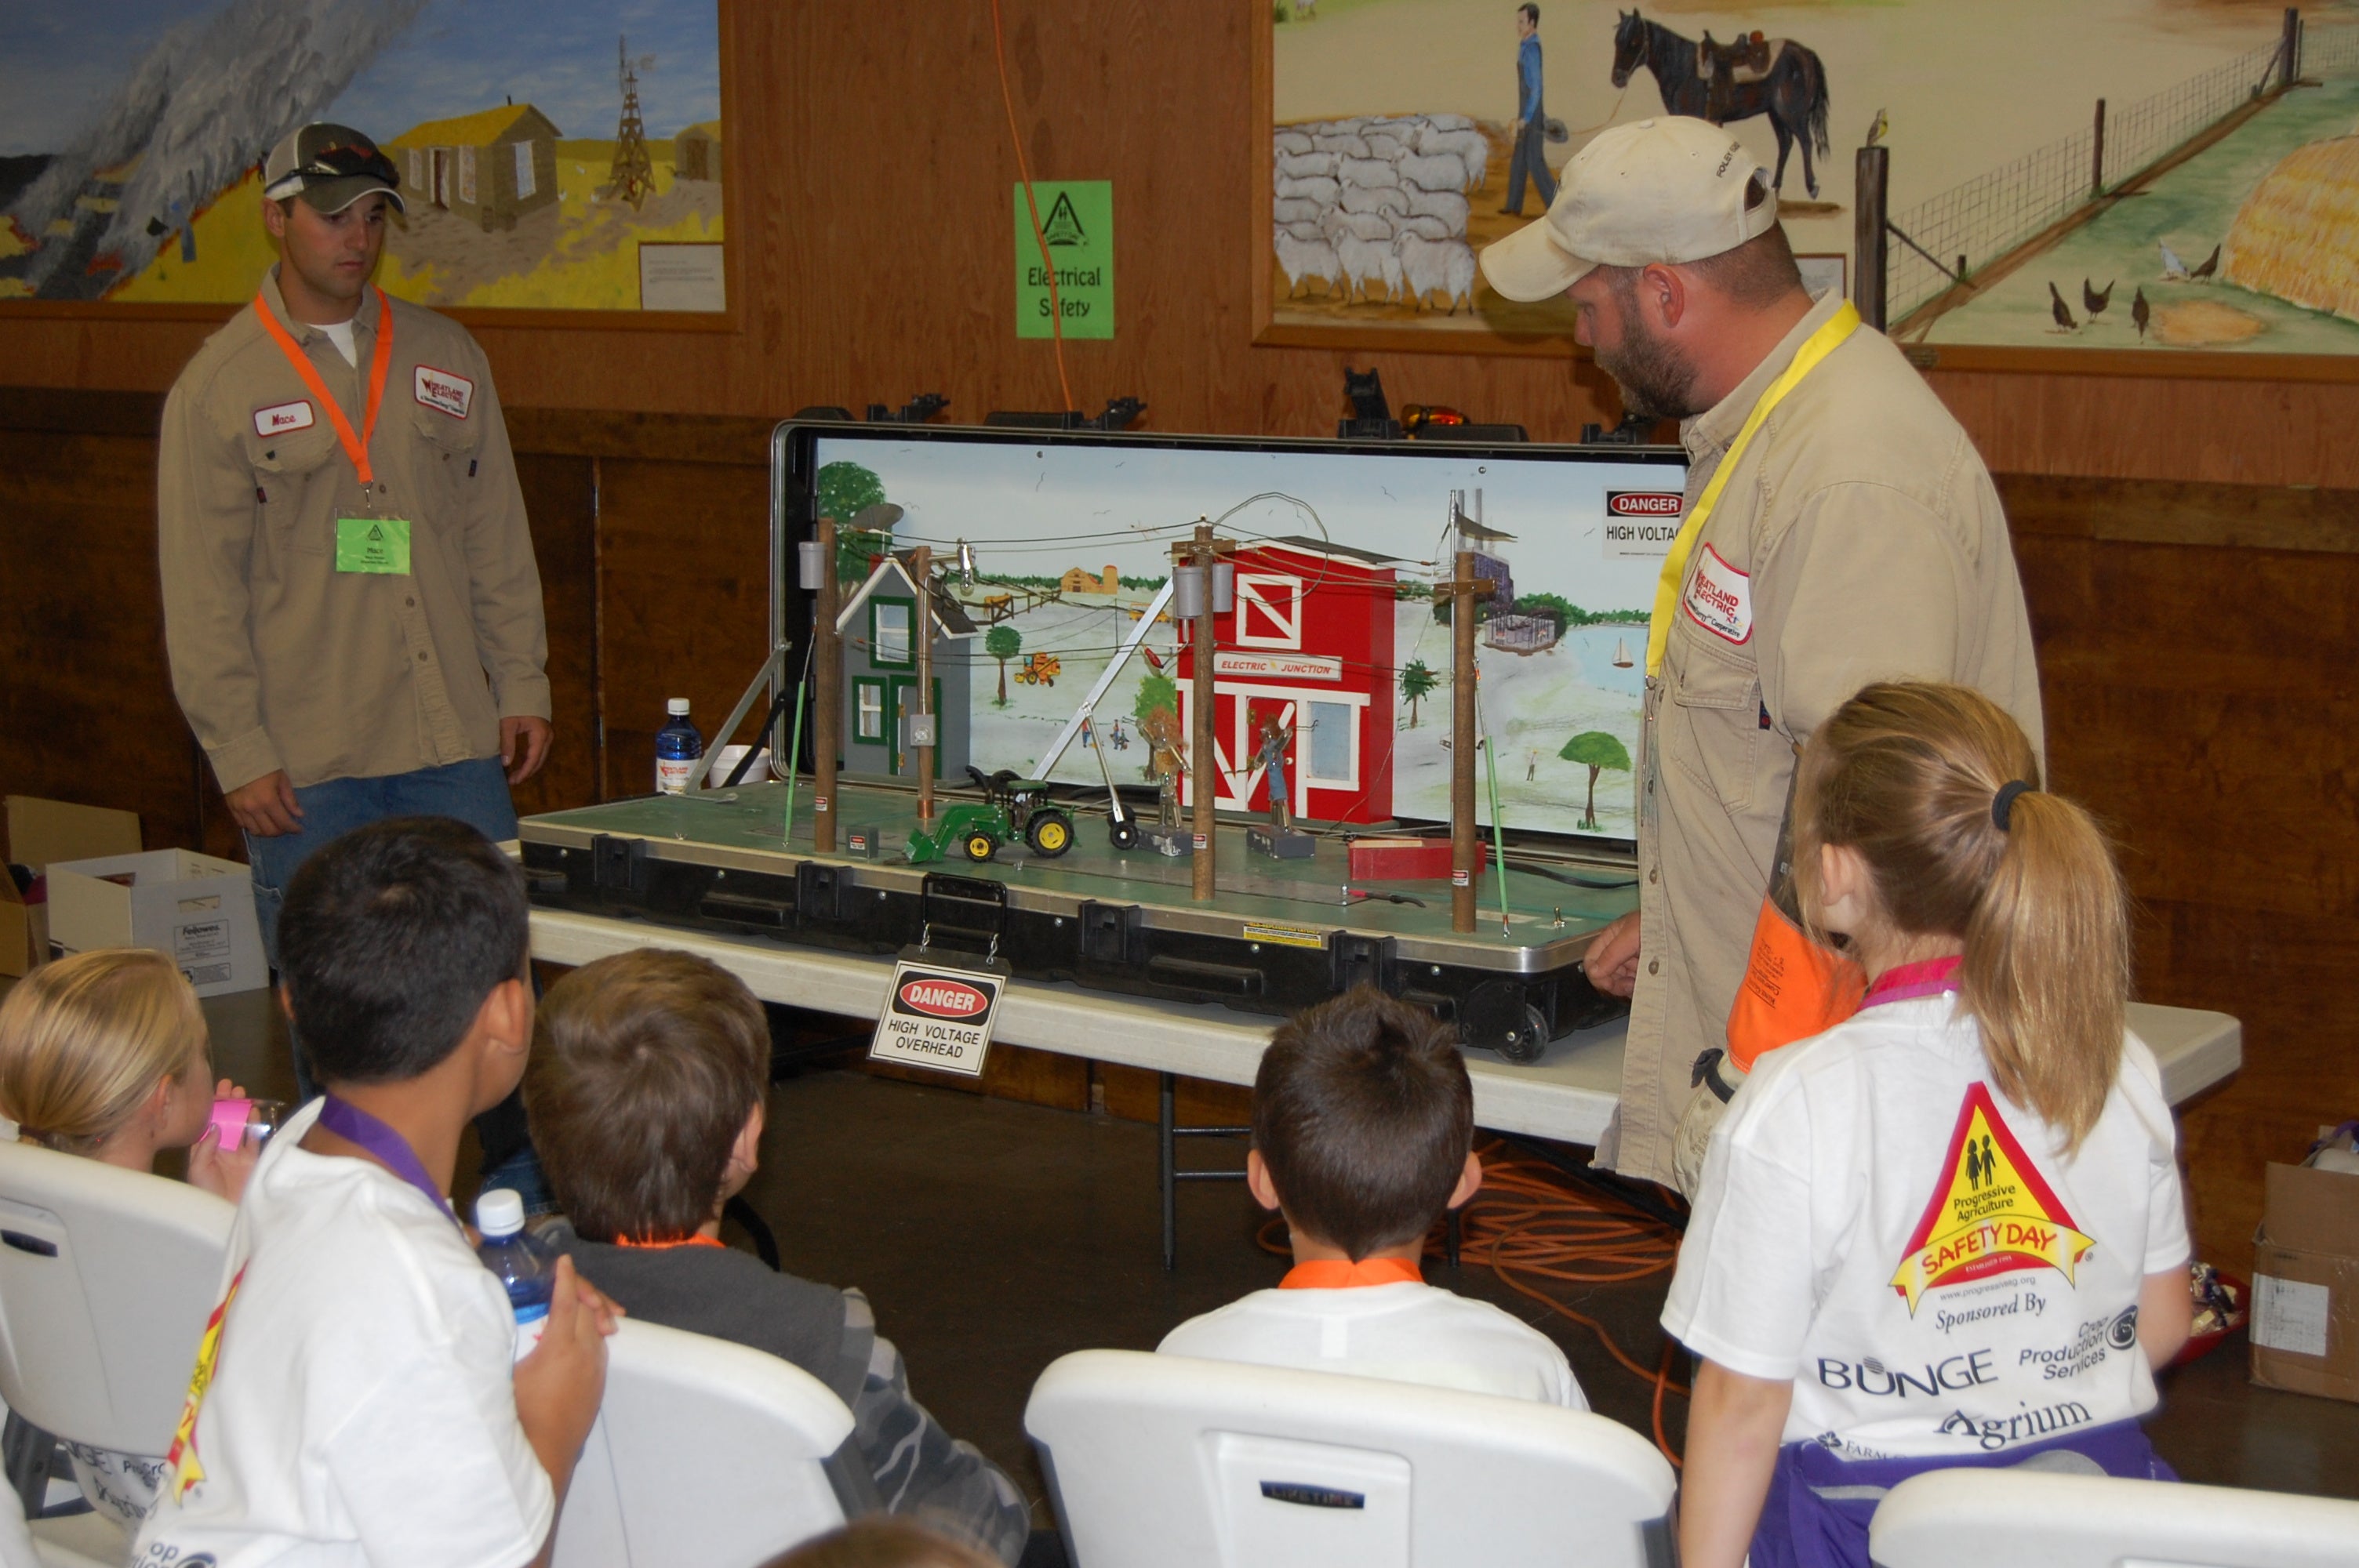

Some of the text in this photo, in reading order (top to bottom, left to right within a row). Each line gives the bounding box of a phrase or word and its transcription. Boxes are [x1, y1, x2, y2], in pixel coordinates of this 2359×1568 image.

[1039, 298, 1091, 317] Sfety
[271, 413, 296, 426] Mace
[1619, 498, 1678, 511] DANGER
[1606, 525, 1679, 541] HIGH VOLTA
[1221, 660, 1331, 674] ELECTRIC JUNCTION
[909, 985, 976, 1011] DANGER
[888, 1018, 980, 1045] HIGH VOLTAGE
[896, 1036, 964, 1058] OVERHEAD
[1954, 1185, 2016, 1210] Progressive
[1957, 1198, 2014, 1222] Agriculture
[1921, 1222, 2057, 1276] SAFETY DAY
[1936, 1292, 2046, 1333] Sponsored By
[2019, 1330, 2103, 1366] Production
[1816, 1348, 1999, 1398] BUNGE
[2043, 1348, 2106, 1380] Services
[1933, 1400, 2093, 1450] Agrium
[151, 1542, 180, 1563] op
